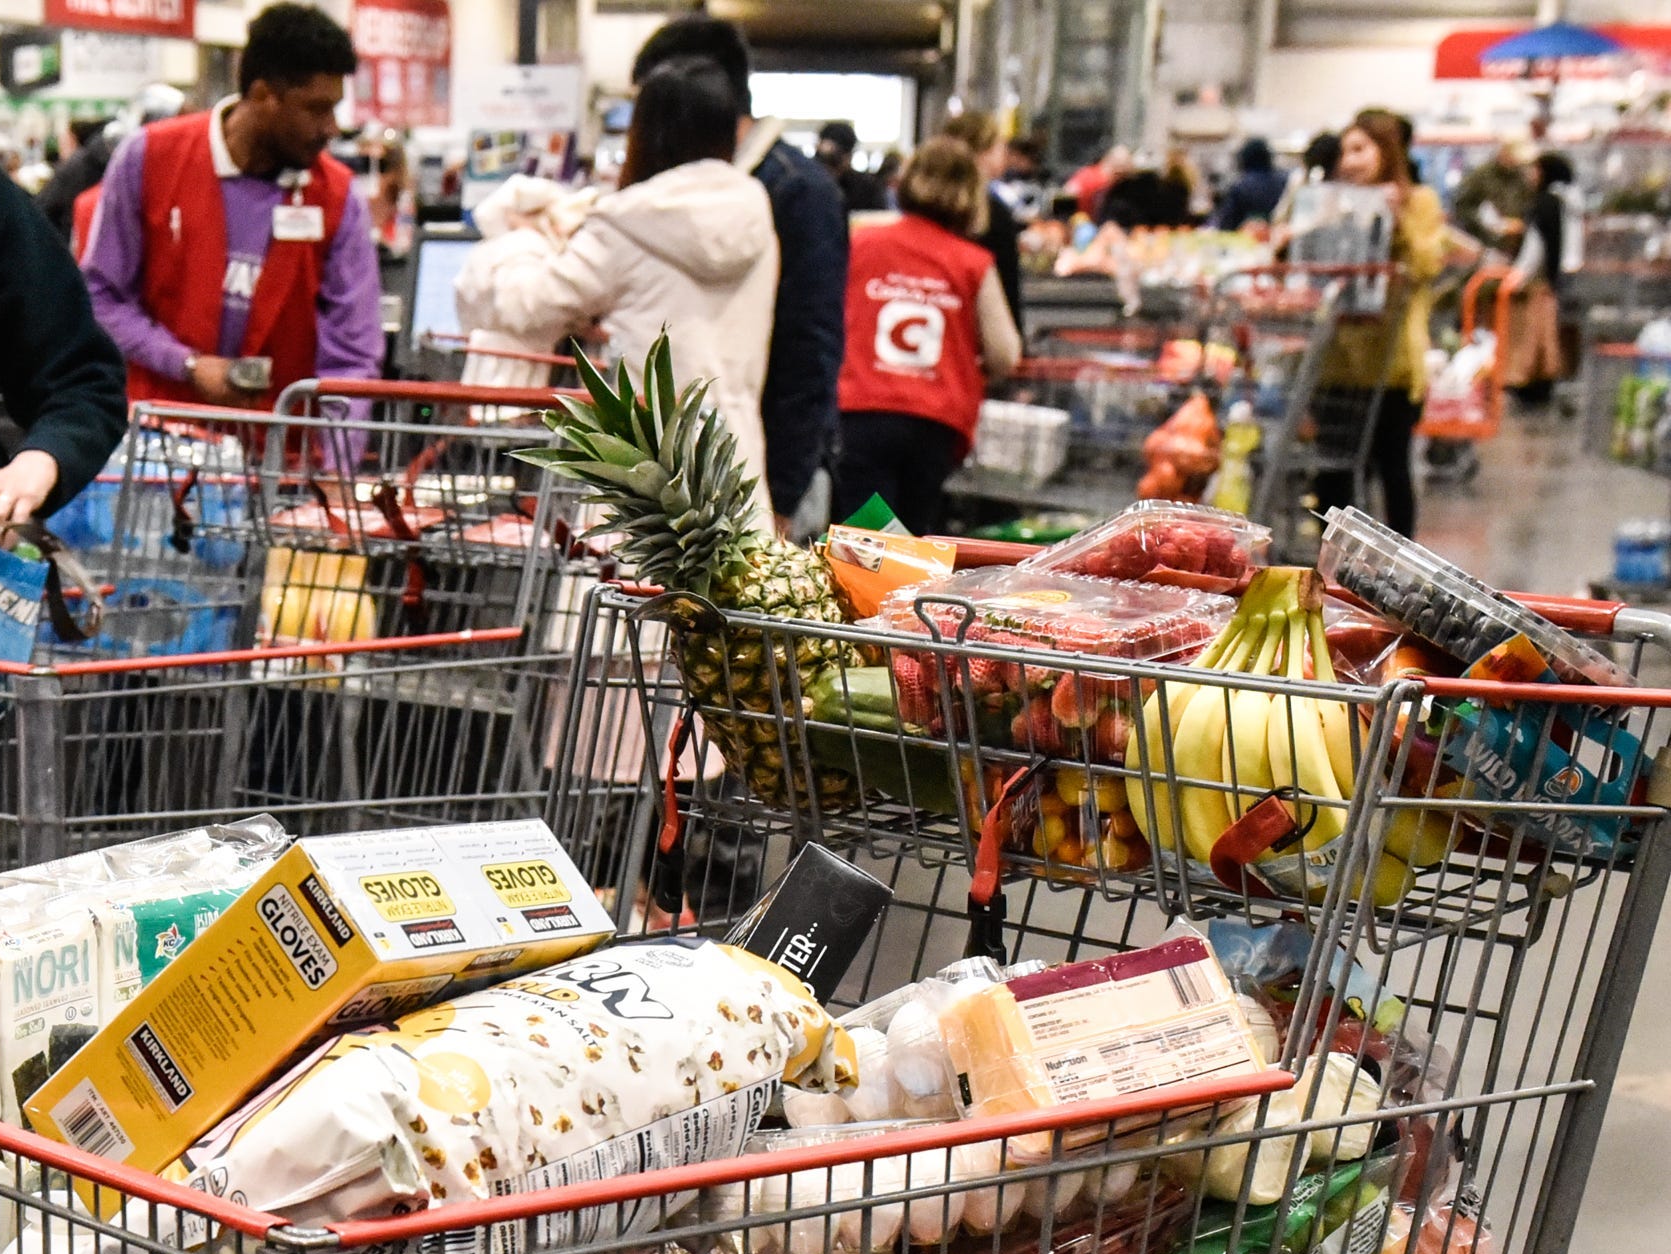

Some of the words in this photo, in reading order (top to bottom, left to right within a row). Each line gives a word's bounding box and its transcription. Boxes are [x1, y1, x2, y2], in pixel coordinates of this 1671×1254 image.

[364, 876, 441, 904] GLOVES
[487, 865, 558, 891] GLOVES
[278, 893, 309, 937] NITRILE
[306, 932, 330, 967] EXAM
[305, 877, 351, 940] KIRKLAND
[532, 915, 581, 930] KIRKLAND
[261, 898, 326, 986] GLOVES
[410, 927, 464, 948] KIRKLAND
[12, 938, 90, 1006] NORI
[568, 1018, 599, 1048] SALT
[139, 1028, 187, 1097] KIRKLAND
